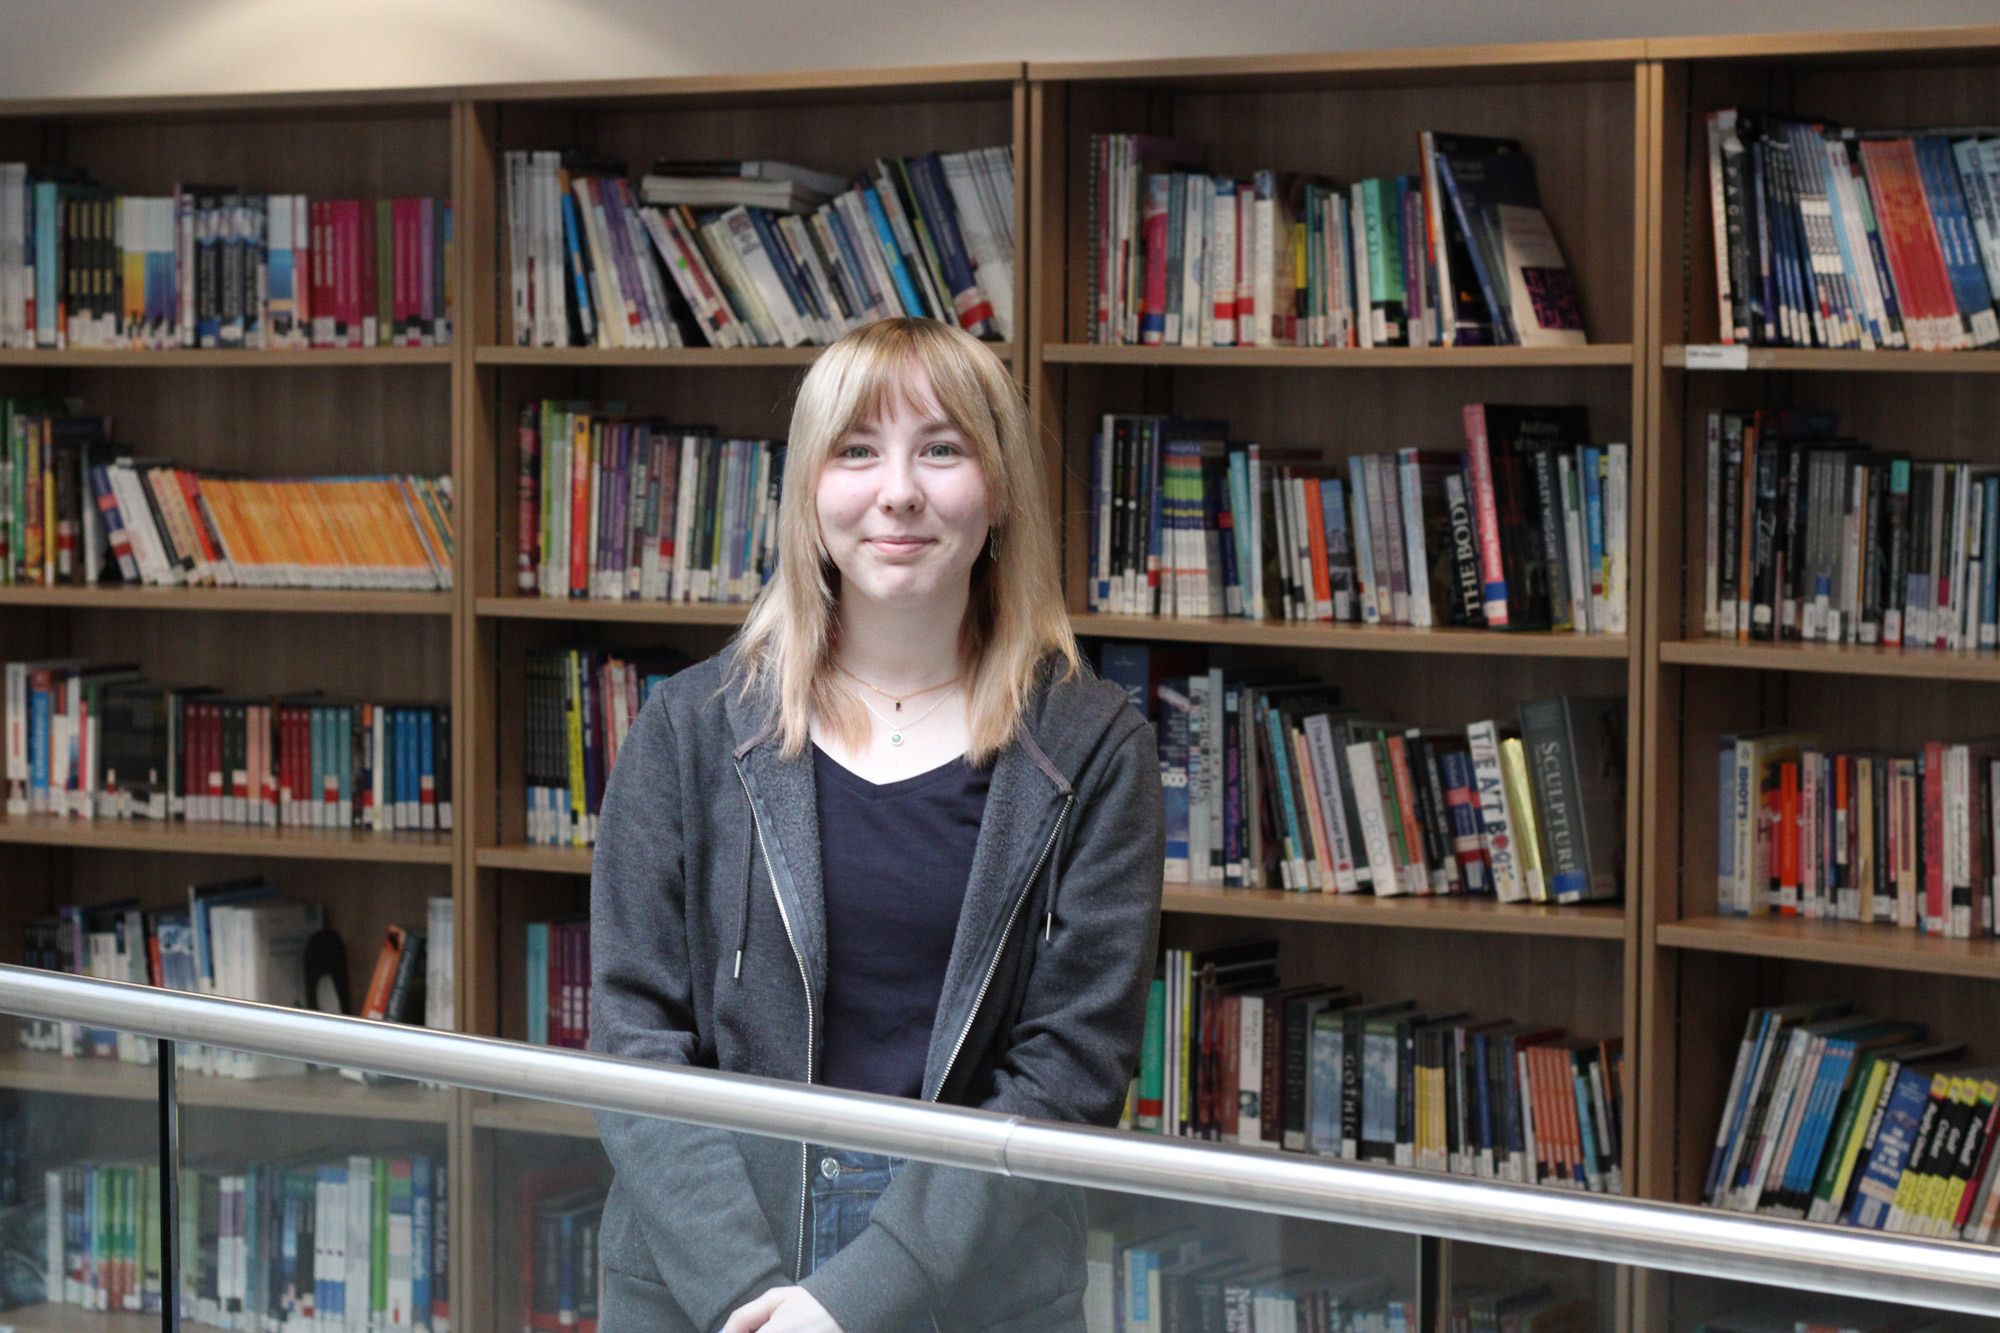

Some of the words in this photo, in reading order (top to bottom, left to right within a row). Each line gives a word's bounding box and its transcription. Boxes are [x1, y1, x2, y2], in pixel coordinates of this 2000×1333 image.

[1459, 563, 1481, 617] THE
[1317, 744, 1332, 797] Advertising
[1326, 798, 1339, 836] Concept
[1335, 837, 1345, 859] Book
[1363, 808, 1386, 867] DECO
[1344, 1054, 1357, 1137] GOTHIC
